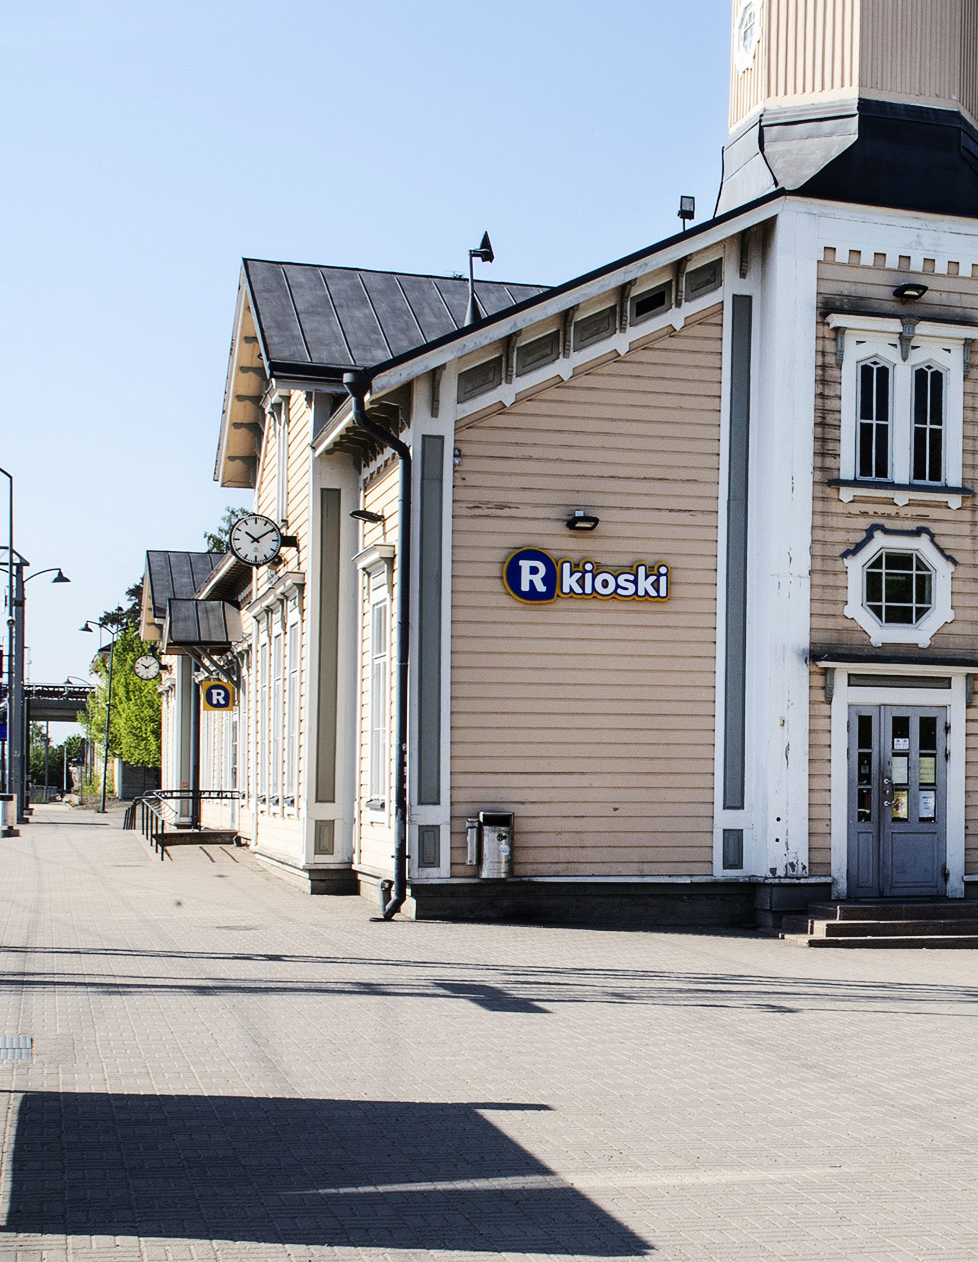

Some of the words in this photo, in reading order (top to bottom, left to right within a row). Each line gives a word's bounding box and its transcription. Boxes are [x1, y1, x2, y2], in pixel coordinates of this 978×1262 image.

[519, 560, 547, 592] R
[562, 562, 668, 597] kioski
[211, 689, 226, 704] R
